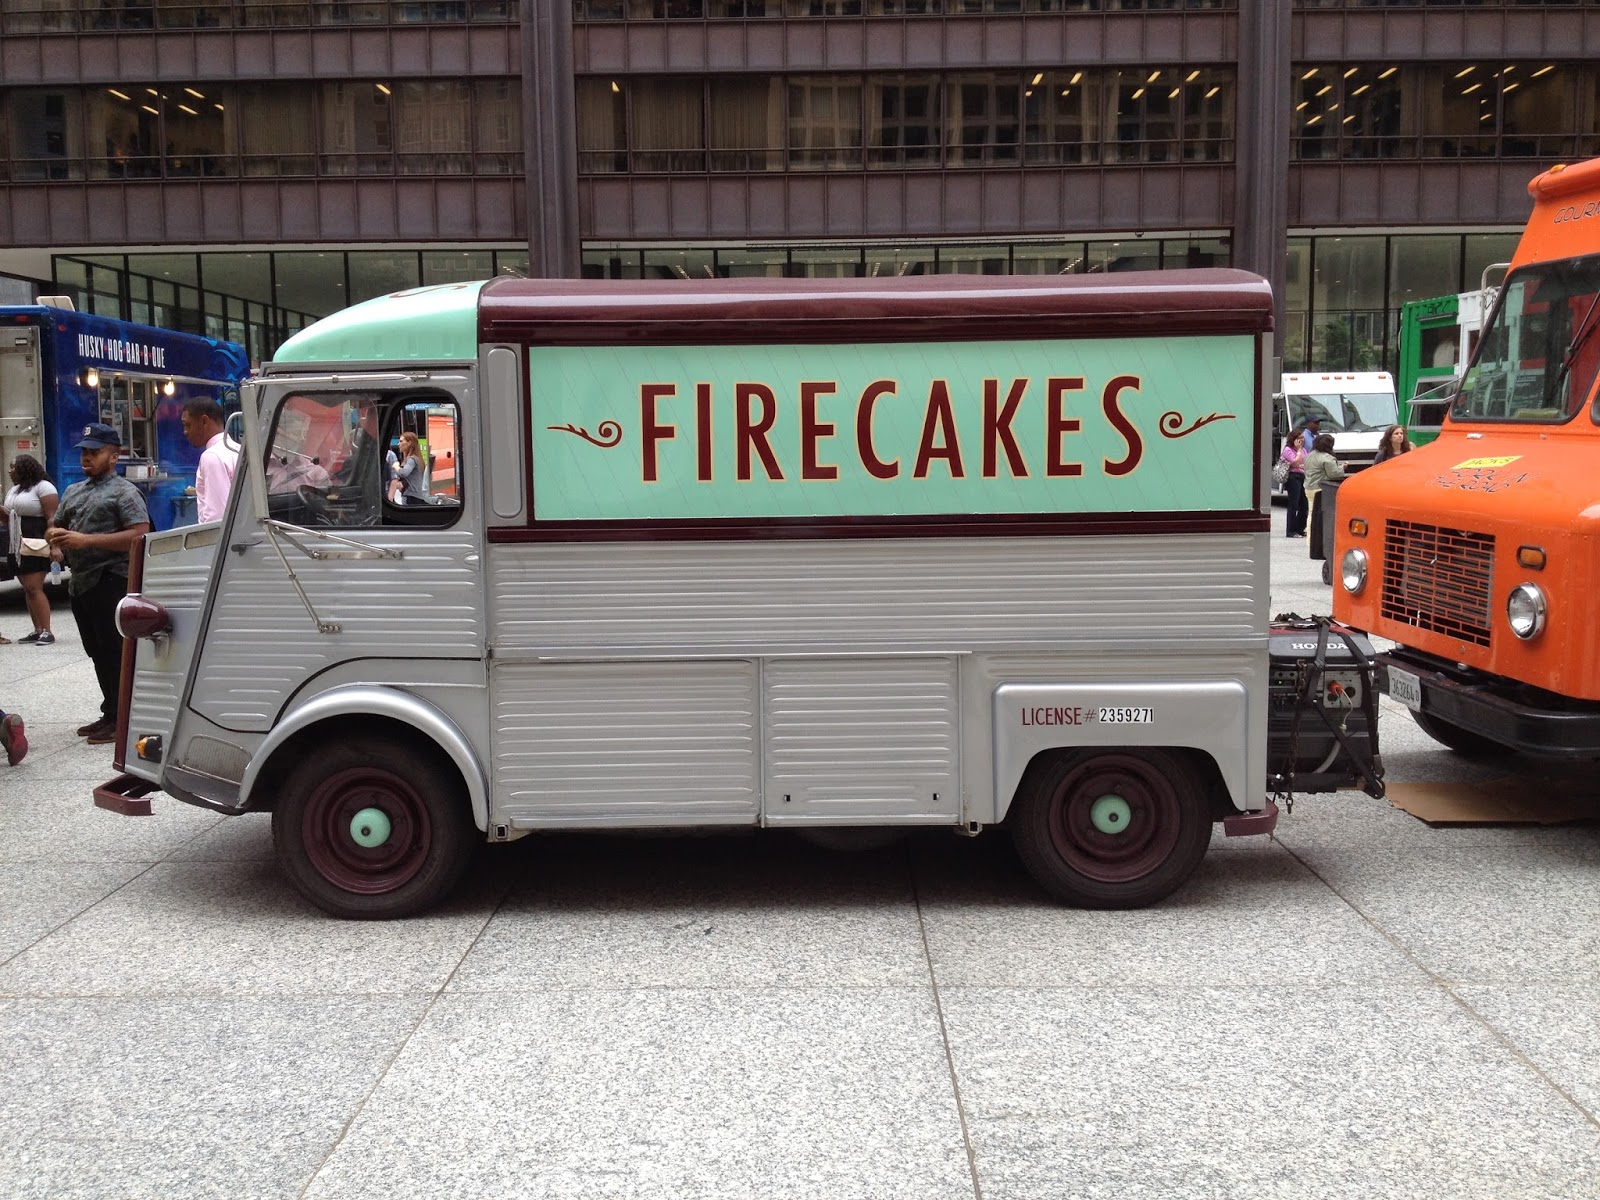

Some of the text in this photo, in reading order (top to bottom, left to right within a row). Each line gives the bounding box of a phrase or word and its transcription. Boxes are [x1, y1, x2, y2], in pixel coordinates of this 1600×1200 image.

[78, 333, 104, 359] HUSKY
[107, 338, 123, 362] HOG
[125, 341, 140, 365] BAR
[143, 344, 149, 366] B
[640, 374, 1144, 483] FIRECAKES
[1100, 708, 1153, 722] 2359271
